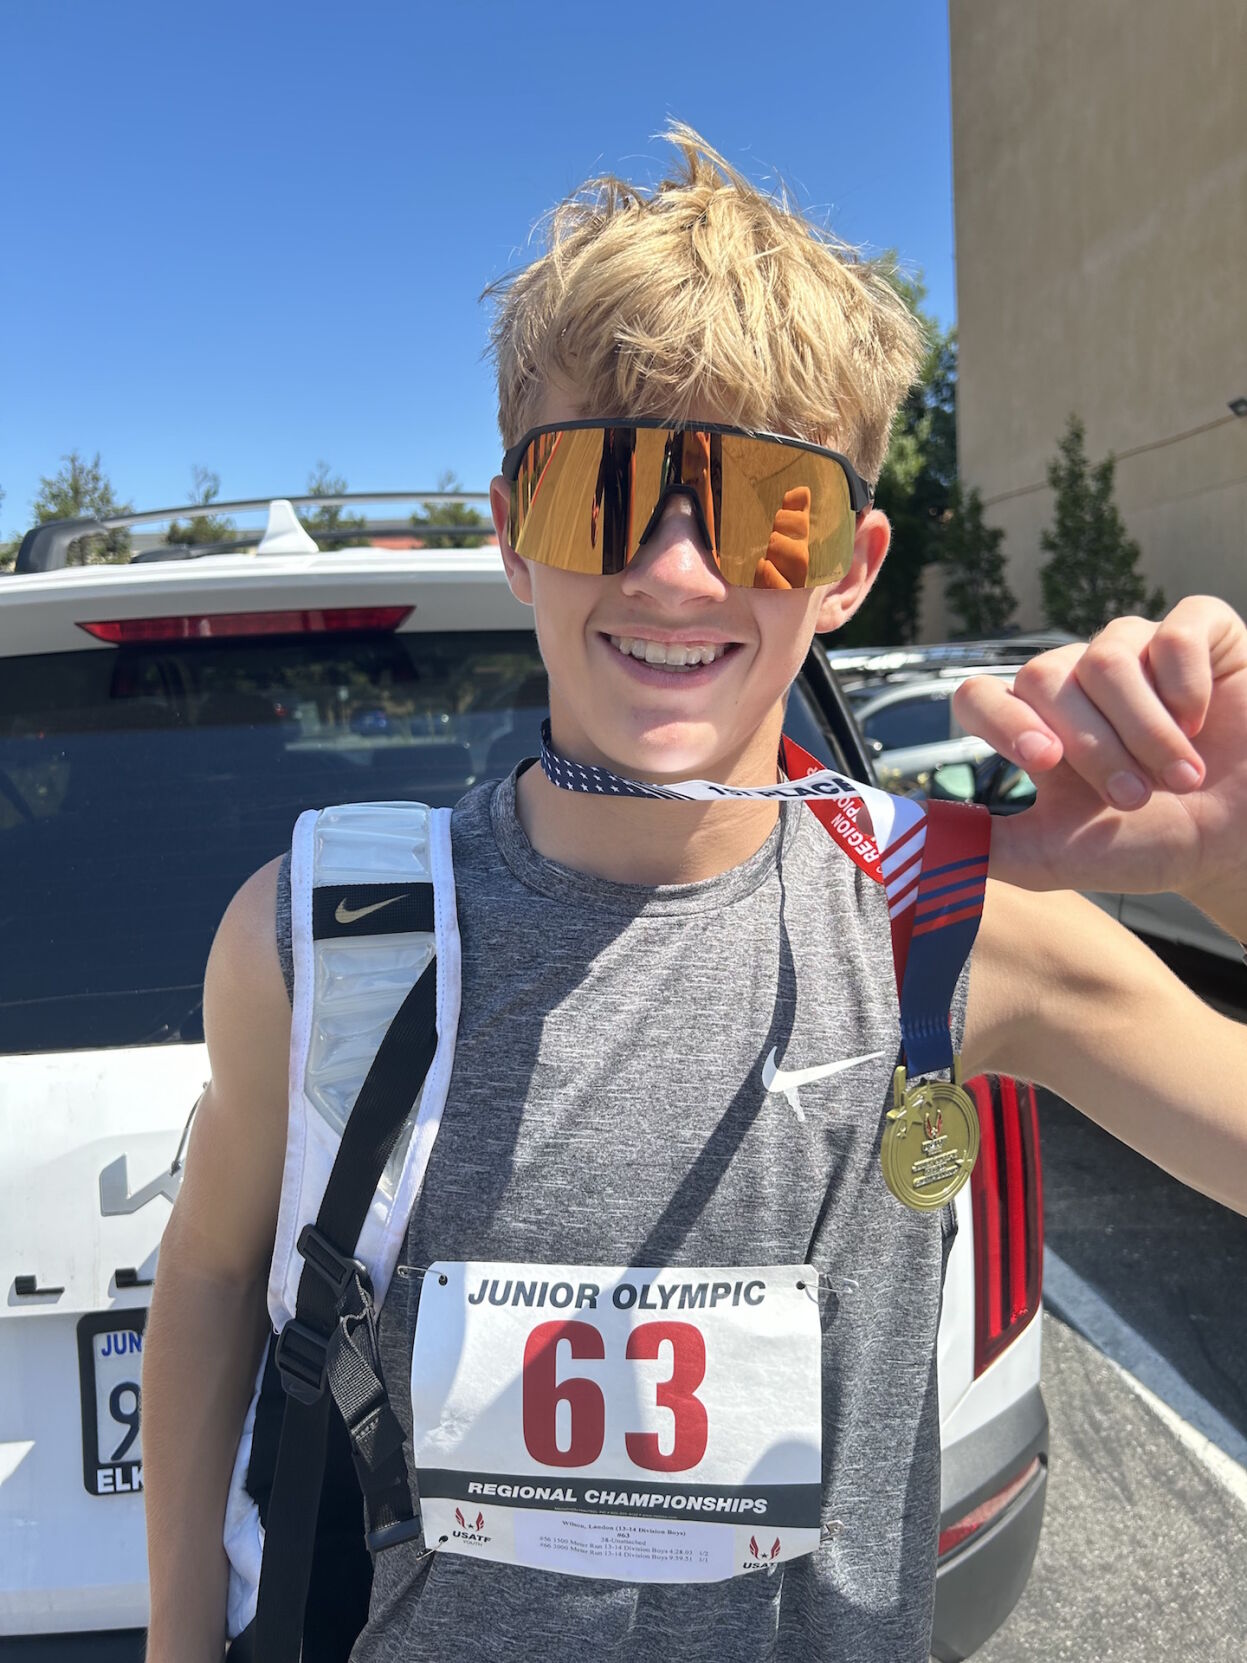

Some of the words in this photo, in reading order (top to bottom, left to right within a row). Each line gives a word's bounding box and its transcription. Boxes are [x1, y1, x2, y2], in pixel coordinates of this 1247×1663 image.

[756, 778, 856, 798] PLACE
[830, 813, 880, 863] REGION
[467, 1279, 599, 1309] JUNIOR
[612, 1279, 766, 1310] OLYMPIC
[522, 1319, 709, 1473] 63
[467, 1481, 579, 1503] REGIONAL
[584, 1488, 768, 1515] CHAMPIONSHIPS
[452, 1530, 492, 1543] USATF
